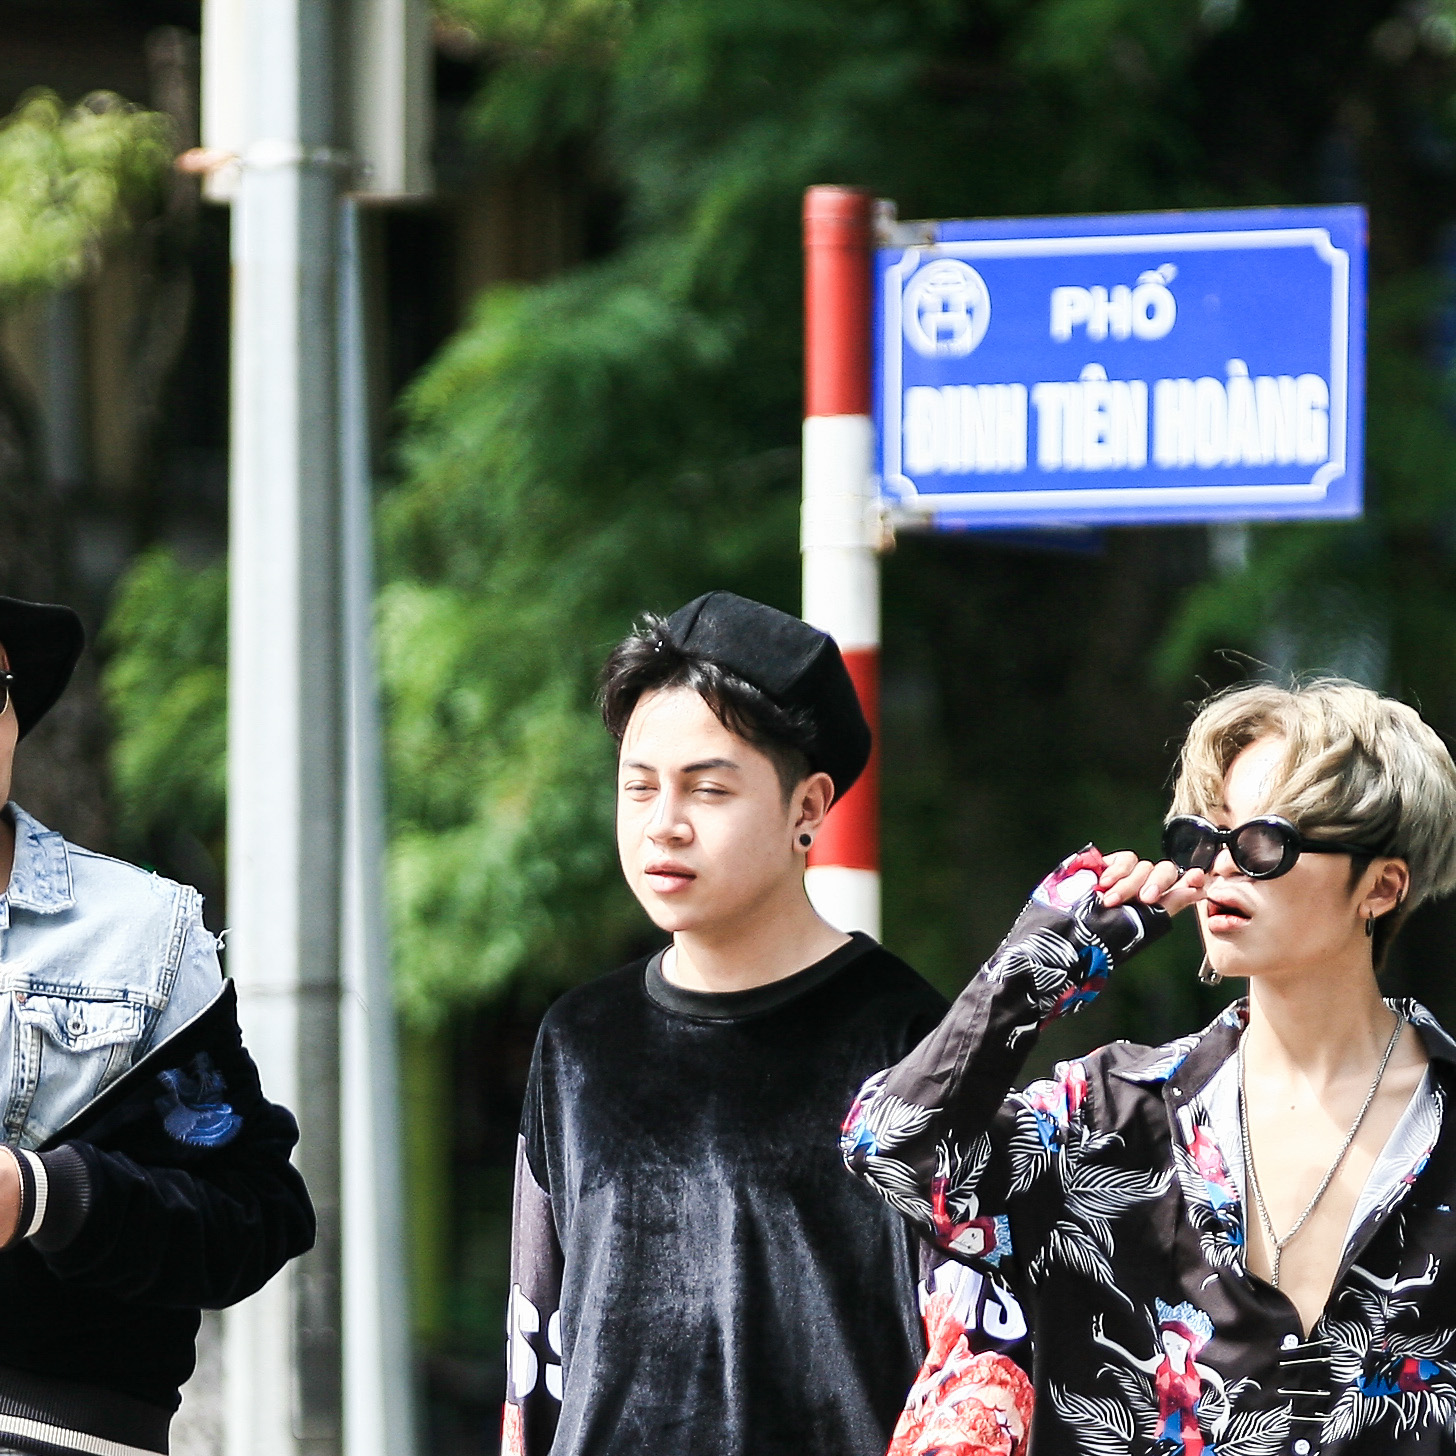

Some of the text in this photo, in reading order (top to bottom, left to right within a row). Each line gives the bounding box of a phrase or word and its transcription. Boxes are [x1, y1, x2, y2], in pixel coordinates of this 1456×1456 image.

[1050, 263, 1178, 342] PHỐ
[1032, 362, 1148, 471] TIÊN
[1154, 358, 1330, 469] HOÀNG
